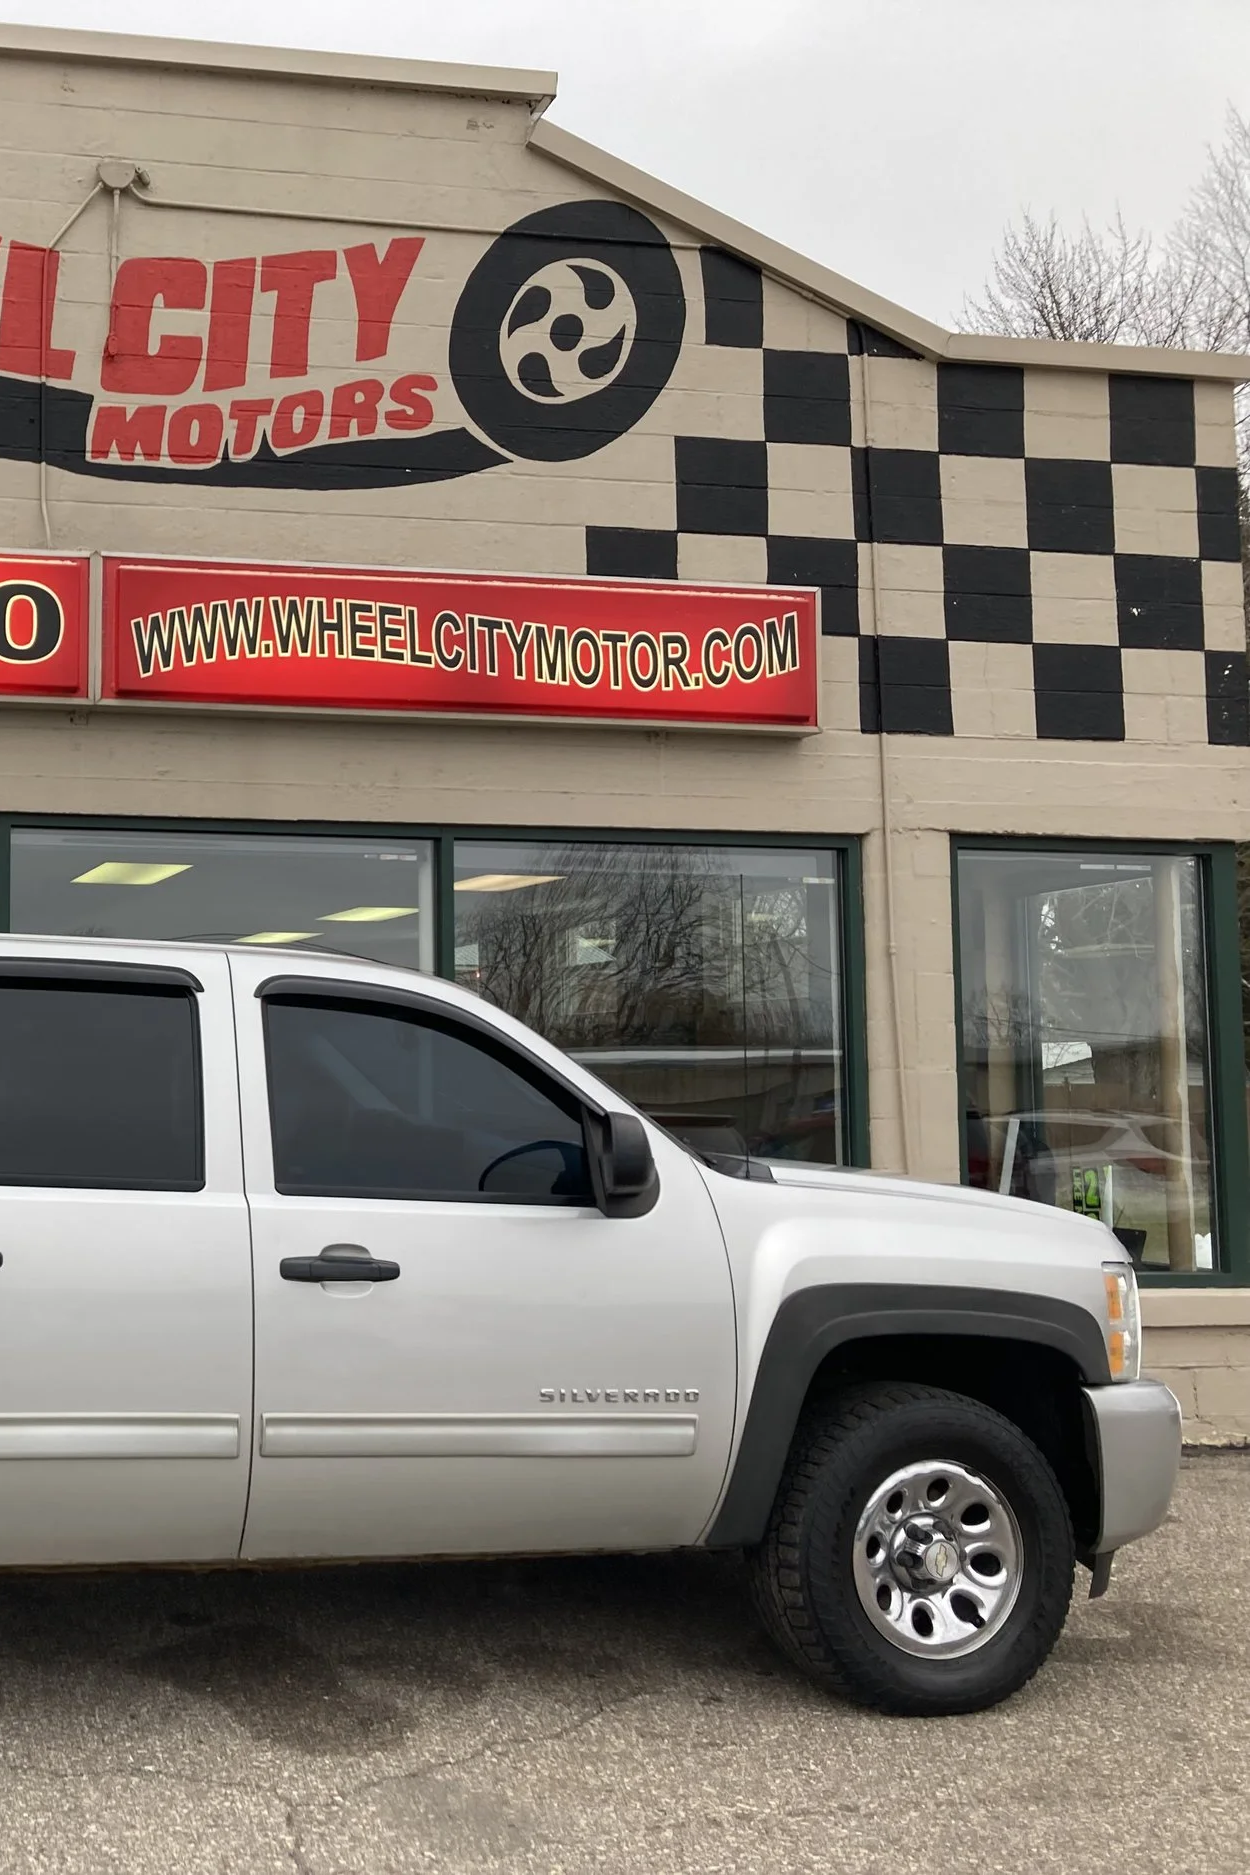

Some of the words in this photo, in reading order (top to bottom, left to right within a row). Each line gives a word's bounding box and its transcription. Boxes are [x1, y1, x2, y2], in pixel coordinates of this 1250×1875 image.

[100, 236, 426, 395] CITY
[91, 373, 439, 465] MOTORS
[130, 596, 801, 692] WWW.WHEELCITYMOTOR.COM
[539, 1388, 699, 1404] SILVERADO
